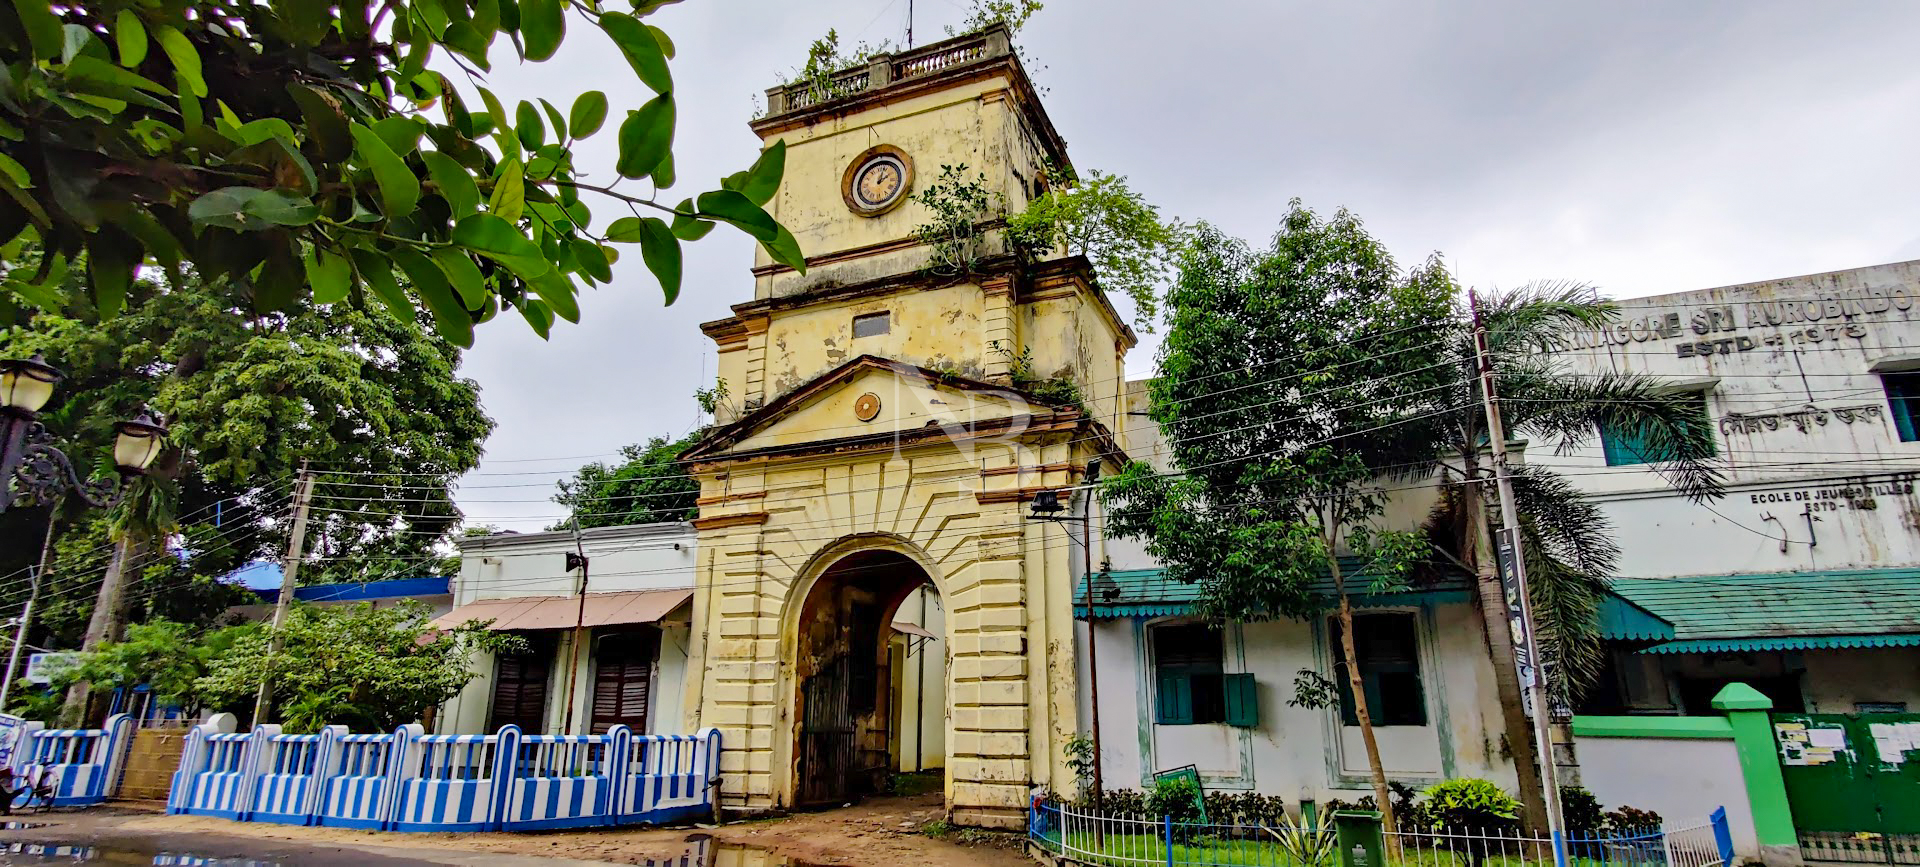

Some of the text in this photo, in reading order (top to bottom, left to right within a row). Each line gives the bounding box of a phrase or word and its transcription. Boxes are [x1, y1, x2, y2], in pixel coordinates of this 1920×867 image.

[1691, 305, 1737, 335] SRI
[1748, 283, 1914, 328] AUROBINDO
[1676, 336, 1756, 358] ESTD
[1789, 322, 1868, 346] 1973
[1751, 484, 1914, 504] ECOLE DE JEUNES FILLES
[1804, 501, 1837, 513] ESTD
